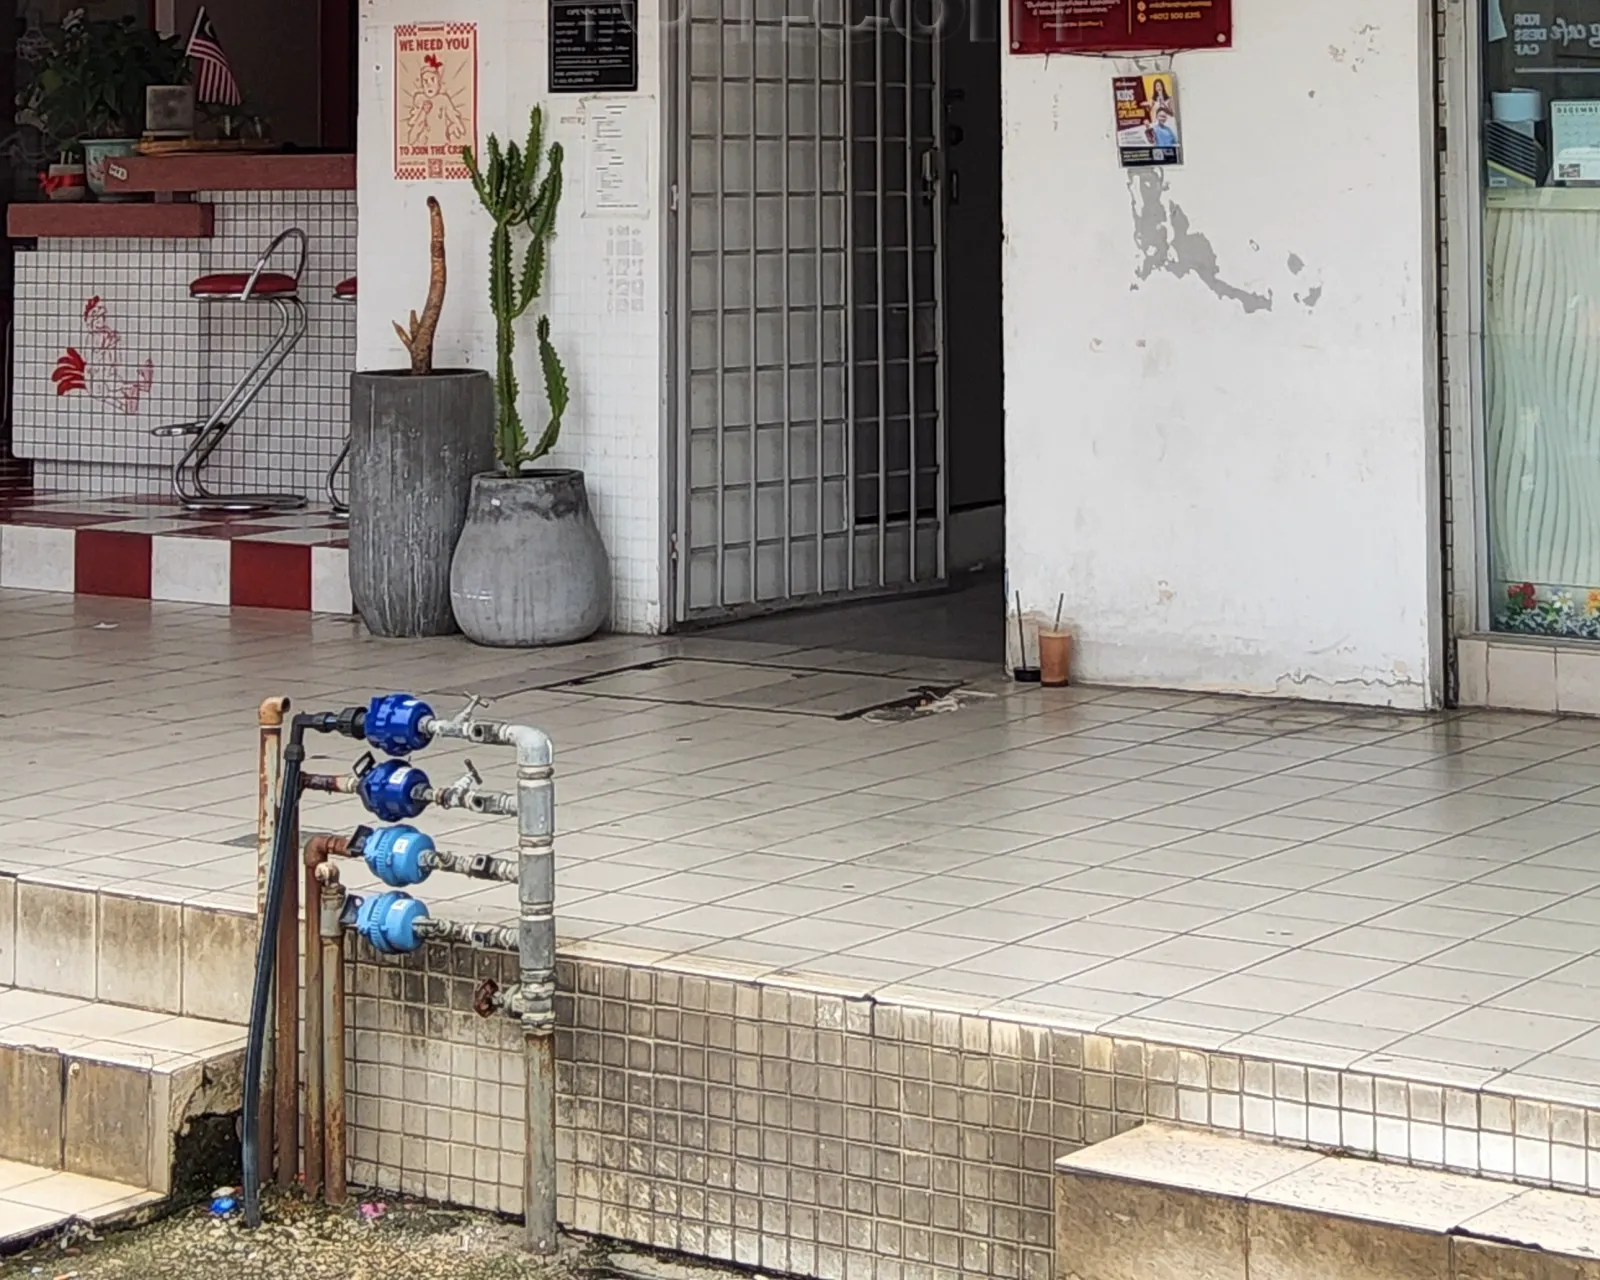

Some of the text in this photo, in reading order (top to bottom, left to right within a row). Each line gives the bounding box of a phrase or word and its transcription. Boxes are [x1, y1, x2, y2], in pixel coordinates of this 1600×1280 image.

[400, 37, 469, 52] WE NEED YOU
[400, 146, 410, 156] TO
[411, 146, 428, 155] JOIN
[431, 145, 445, 155] THE
